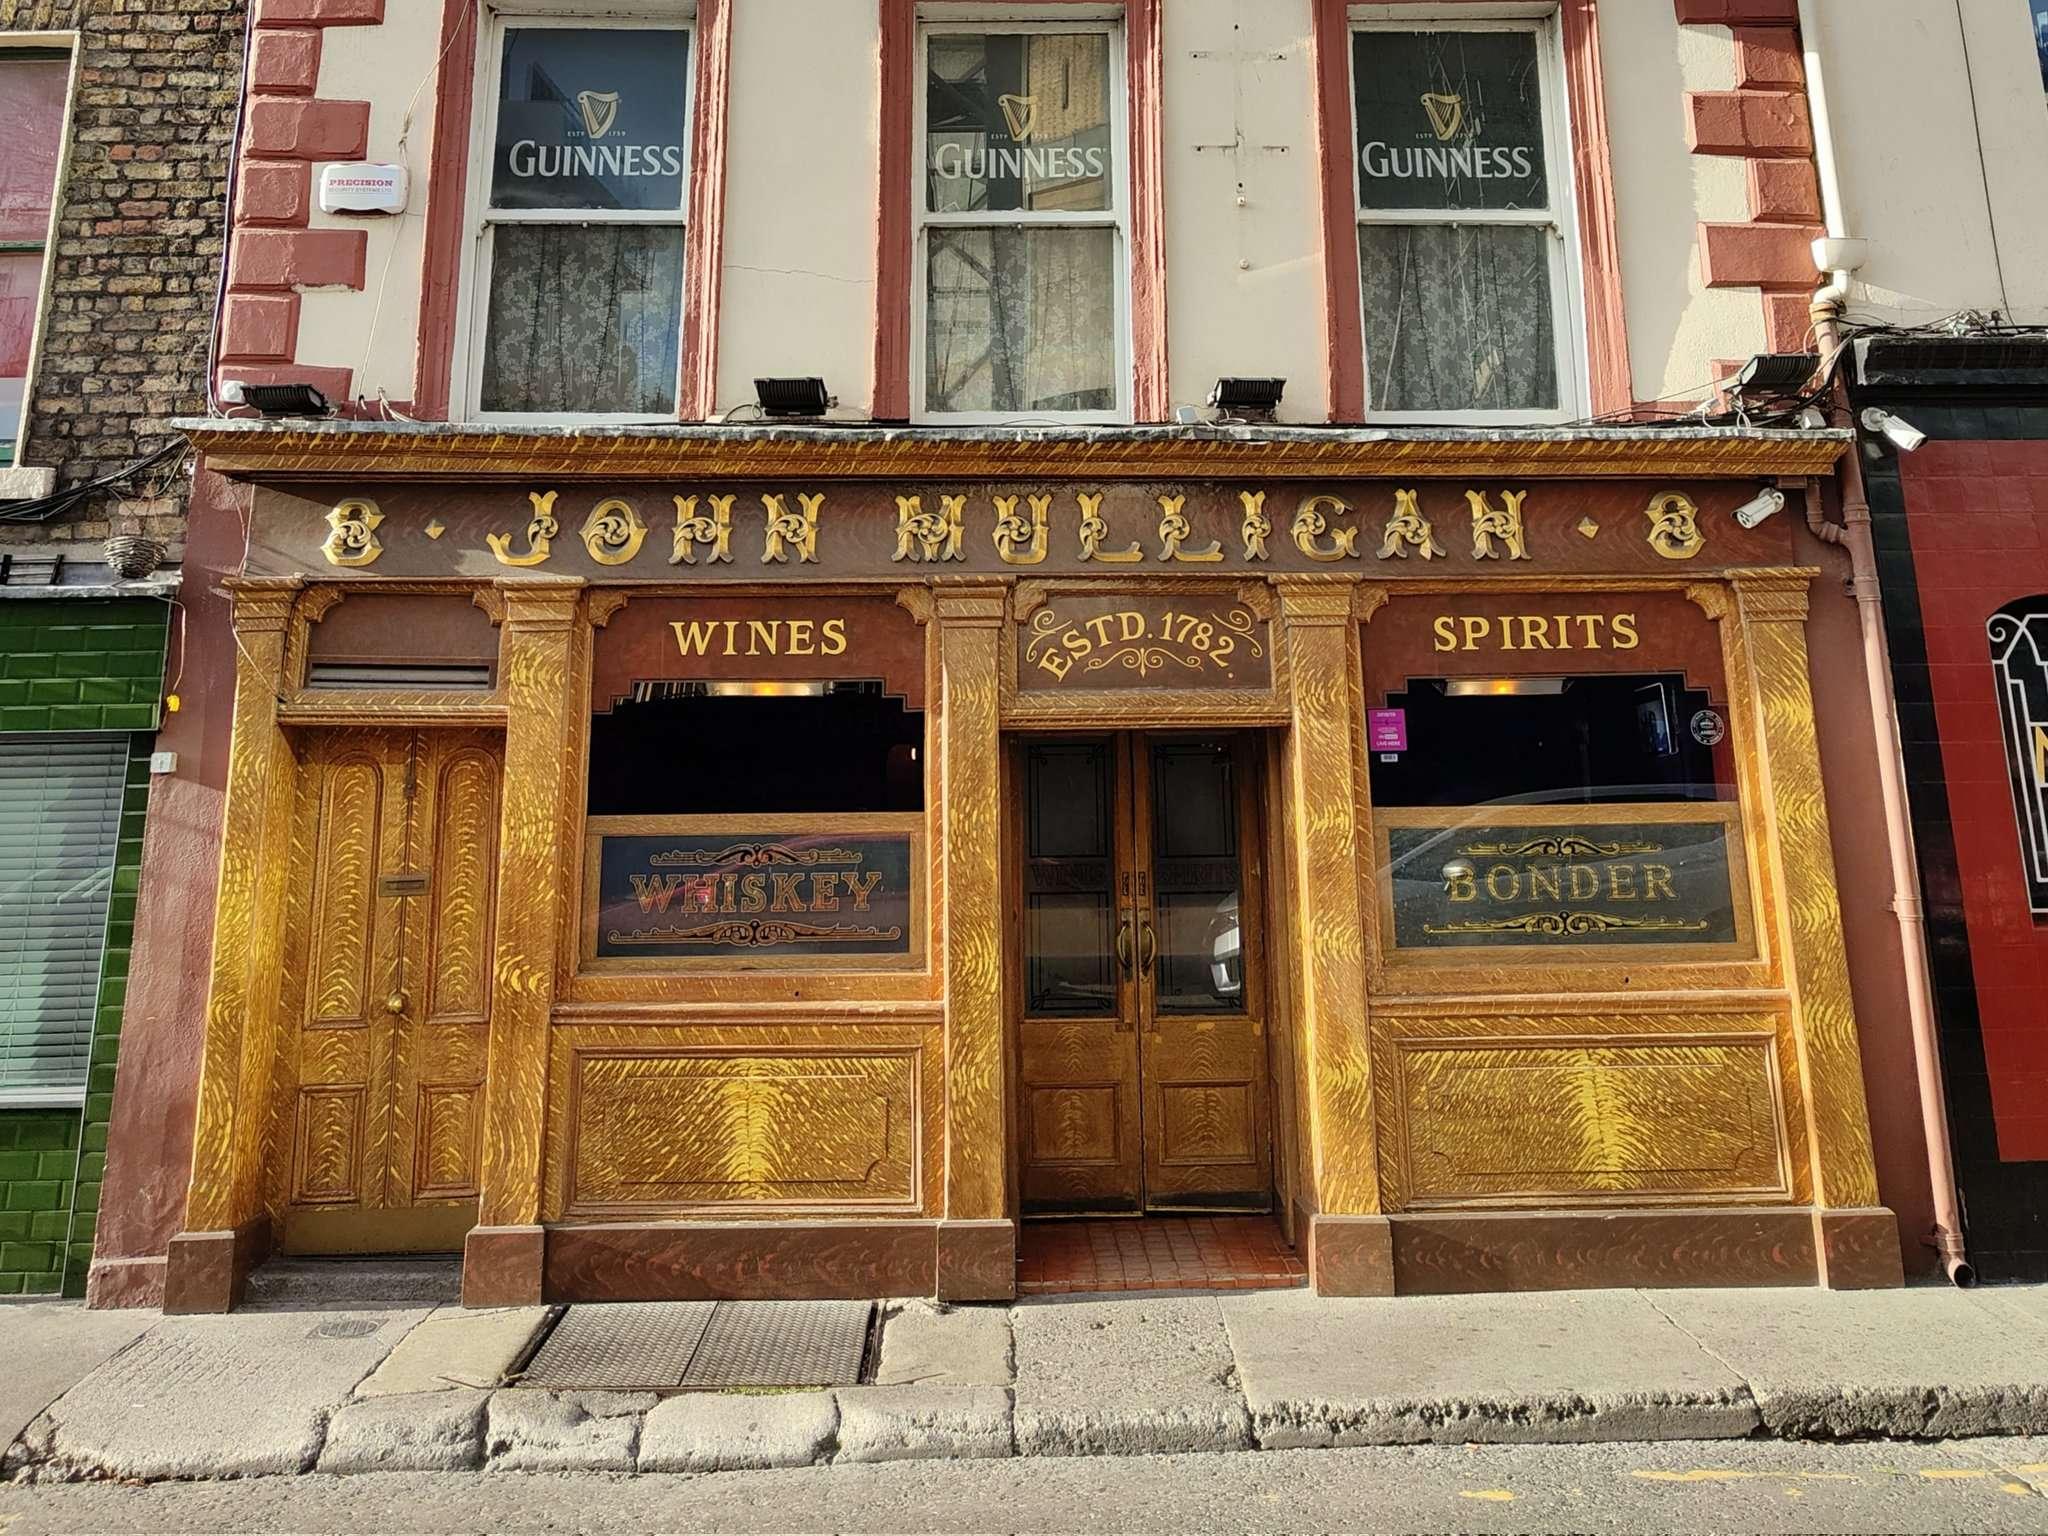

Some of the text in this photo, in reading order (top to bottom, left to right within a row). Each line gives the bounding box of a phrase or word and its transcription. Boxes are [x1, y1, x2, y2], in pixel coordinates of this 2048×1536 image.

[509, 140, 681, 177] GUINNESS
[935, 143, 1104, 179] GUINNESS
[1361, 141, 1532, 178] GUINNESS
[329, 179, 393, 187] PRECISION
[486, 490, 825, 566] JOHN
[892, 488, 1532, 565] MULLIGAN
[670, 618, 848, 657] WINES
[1433, 613, 1639, 652] SPIRITS
[629, 871, 882, 914] WHISKEY
[1446, 862, 1679, 902] BONDER
